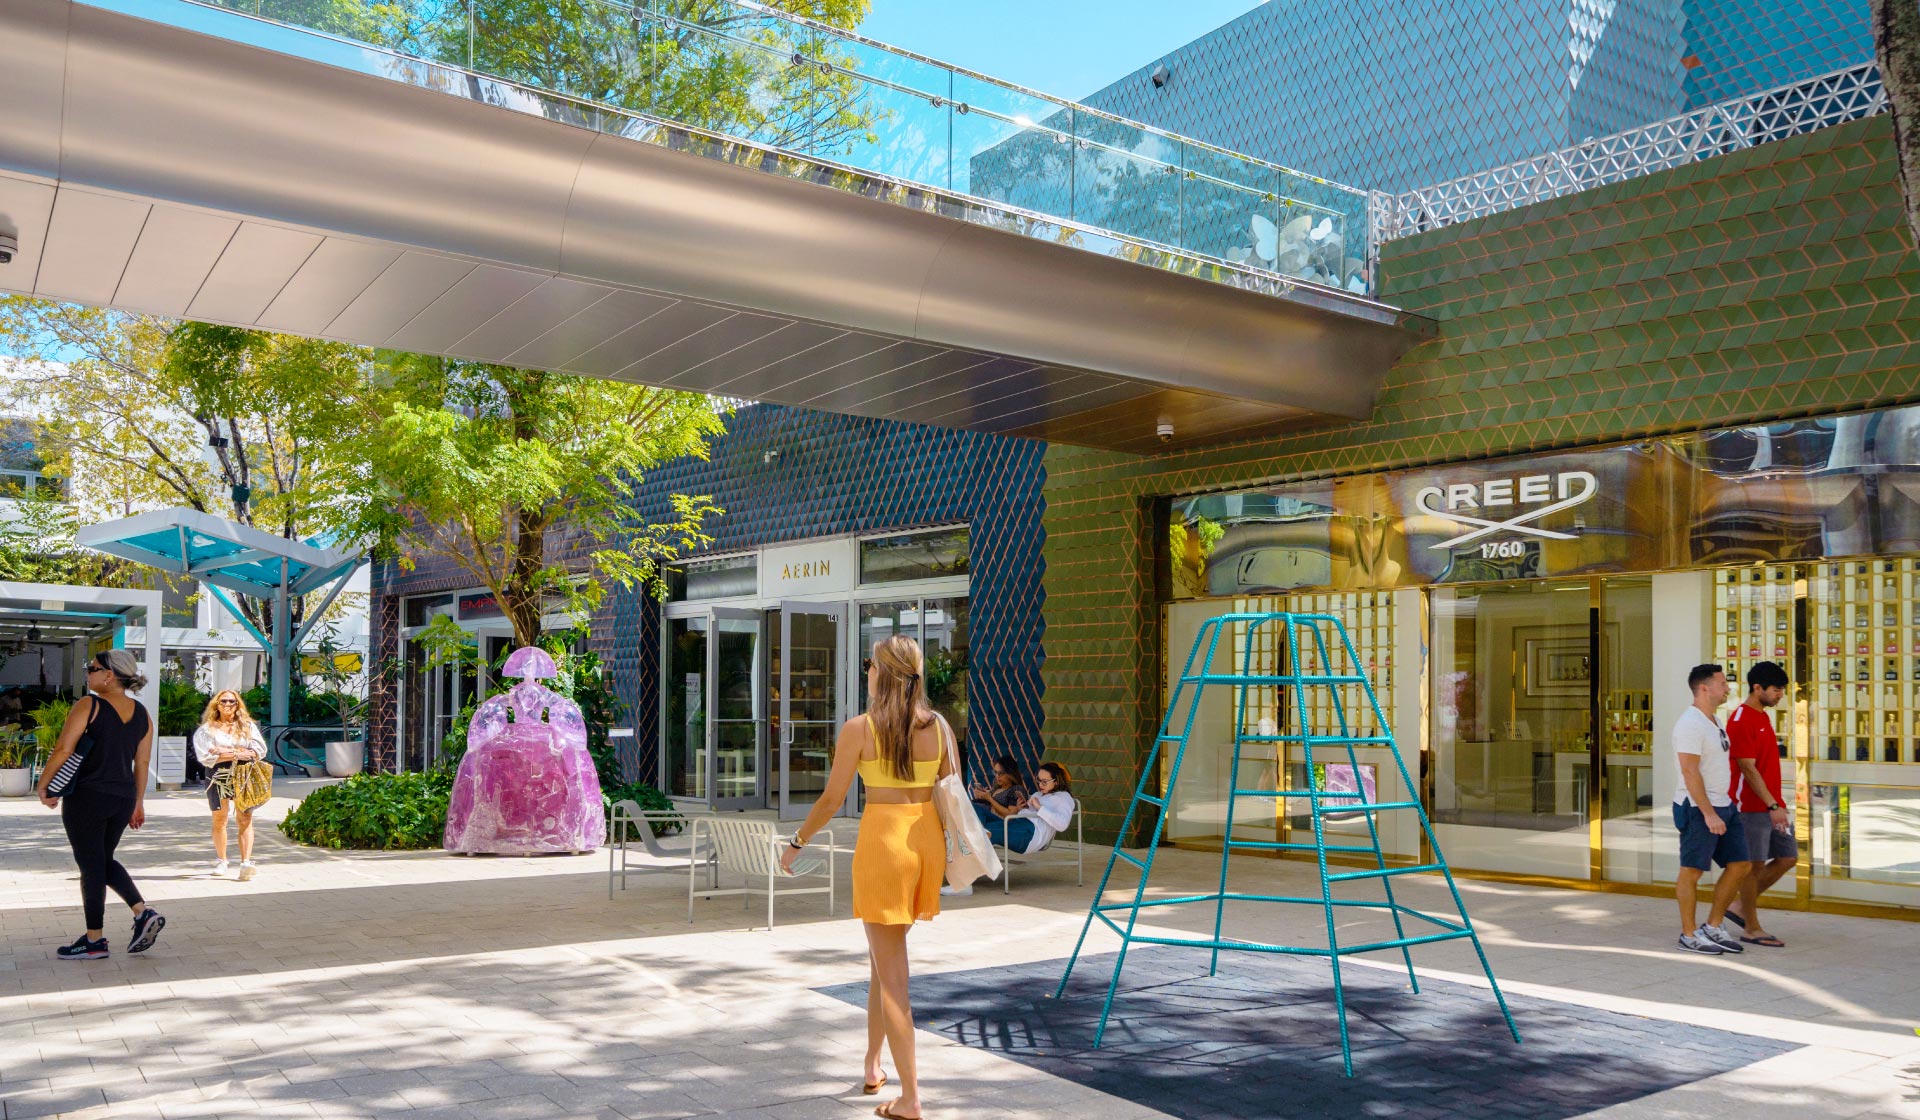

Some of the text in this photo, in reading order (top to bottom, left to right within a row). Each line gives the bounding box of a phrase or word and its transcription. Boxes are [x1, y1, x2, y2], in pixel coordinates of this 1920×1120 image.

[1415, 471, 1597, 549] CREED
[1480, 541, 1524, 559] 1760
[781, 559, 830, 580] AERIN
[828, 614, 839, 622] 141
